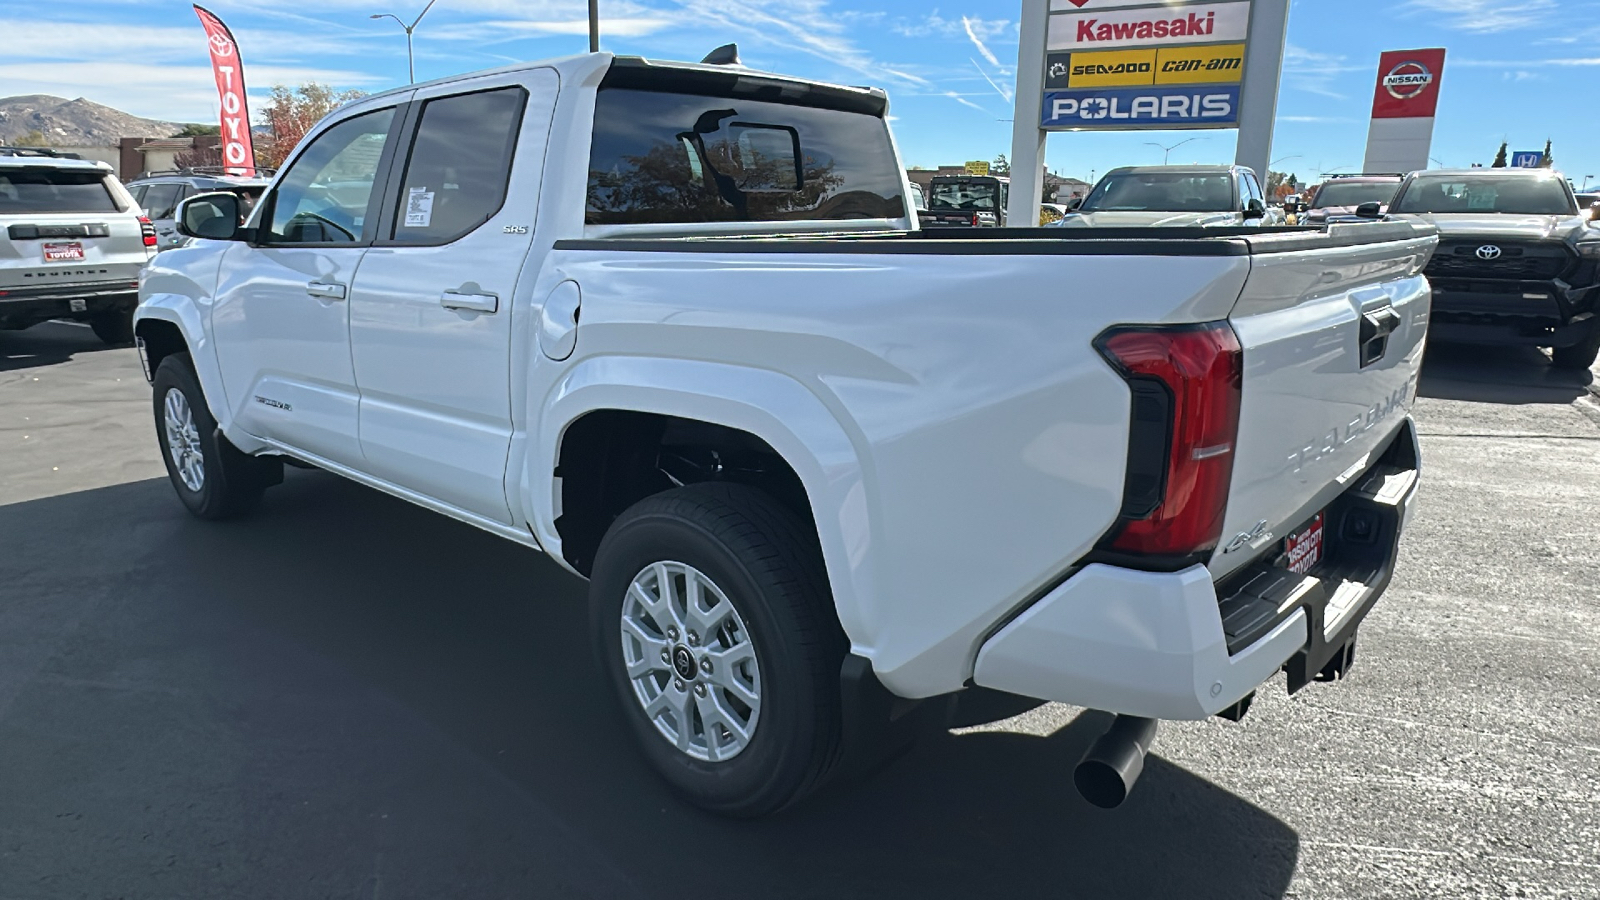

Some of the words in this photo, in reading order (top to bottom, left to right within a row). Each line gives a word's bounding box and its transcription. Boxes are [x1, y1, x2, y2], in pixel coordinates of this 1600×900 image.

[1076, 11, 1215, 42] Kawasaki
[1161, 58, 1241, 73] can-am
[1387, 75, 1428, 84] NISSAN
[1051, 94, 1231, 120] POLARIS
[49, 251, 81, 259] TOYOTA
[1287, 381, 1408, 473] TACOMA
[1287, 536, 1310, 563] ARSON
[1310, 526, 1323, 548] CITY
